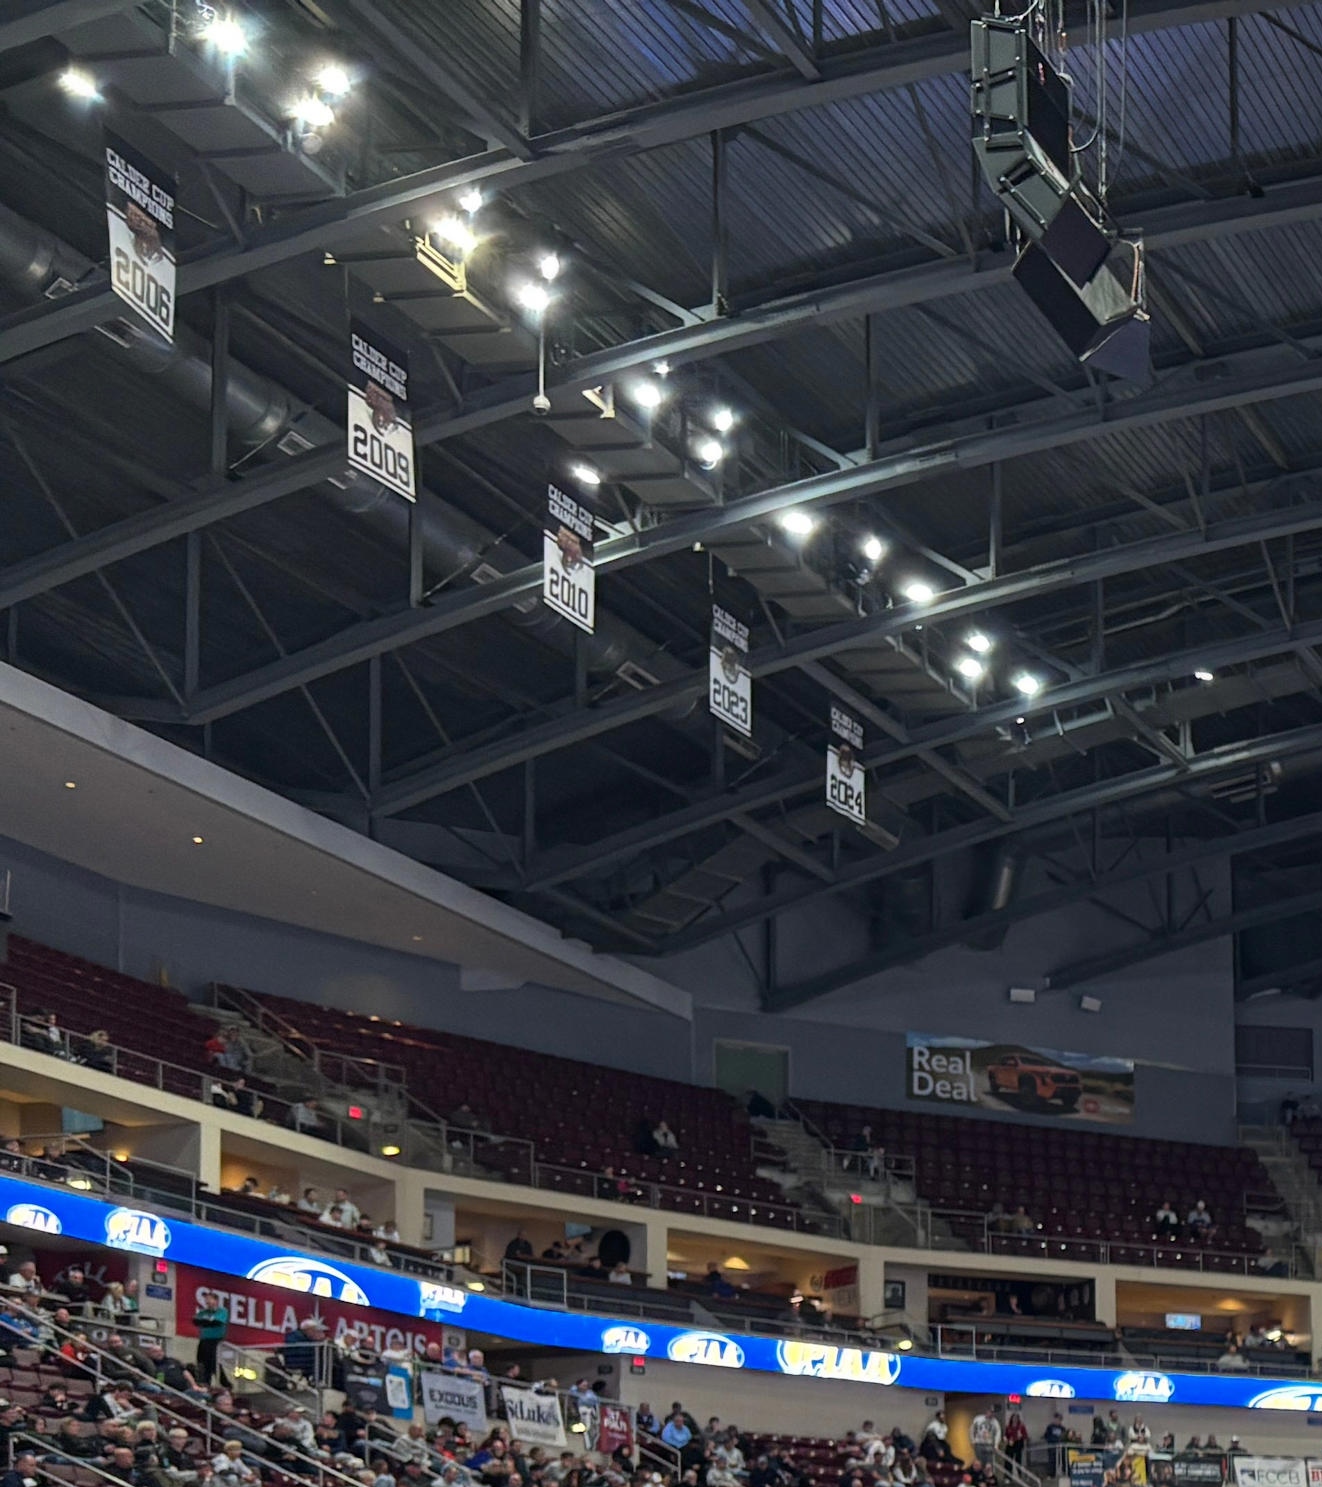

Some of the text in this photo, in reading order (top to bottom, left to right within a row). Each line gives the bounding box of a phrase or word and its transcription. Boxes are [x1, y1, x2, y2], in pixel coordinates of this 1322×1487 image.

[115, 246, 171, 328] 2006
[354, 423, 410, 488] 2009
[549, 567, 588, 619] 2010
[713, 679, 748, 725] 2023
[830, 774, 863, 815] 2024
[912, 1046, 972, 1076] Real
[912, 1072, 977, 1102] Deal
[780, 1340, 897, 1385] PIAA
